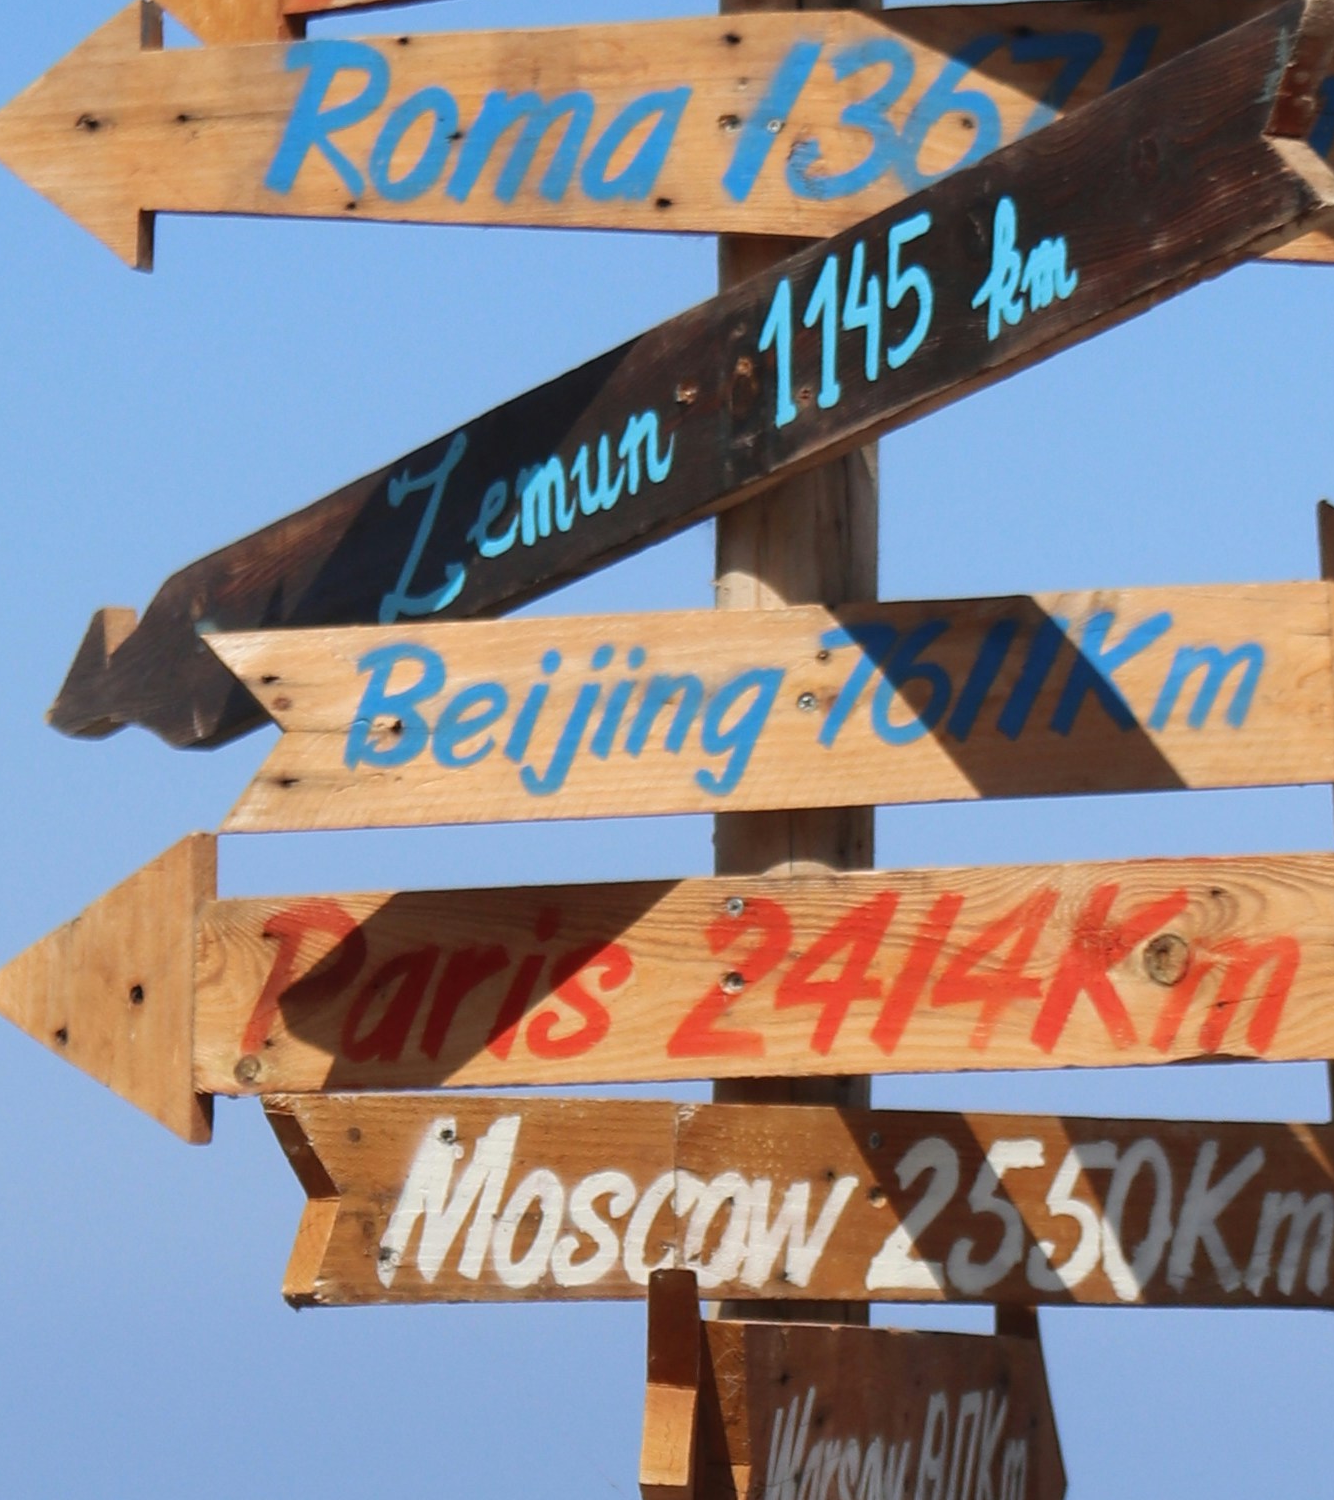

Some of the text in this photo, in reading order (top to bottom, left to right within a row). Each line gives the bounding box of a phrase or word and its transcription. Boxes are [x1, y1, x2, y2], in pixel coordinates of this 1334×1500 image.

[263, 39, 694, 205] Roma
[377, 197, 1078, 624] Zemun 1145 km
[343, 640, 787, 798] Beijing
[240, 897, 637, 1062] Paris
[378, 1114, 861, 1290] Moscow
